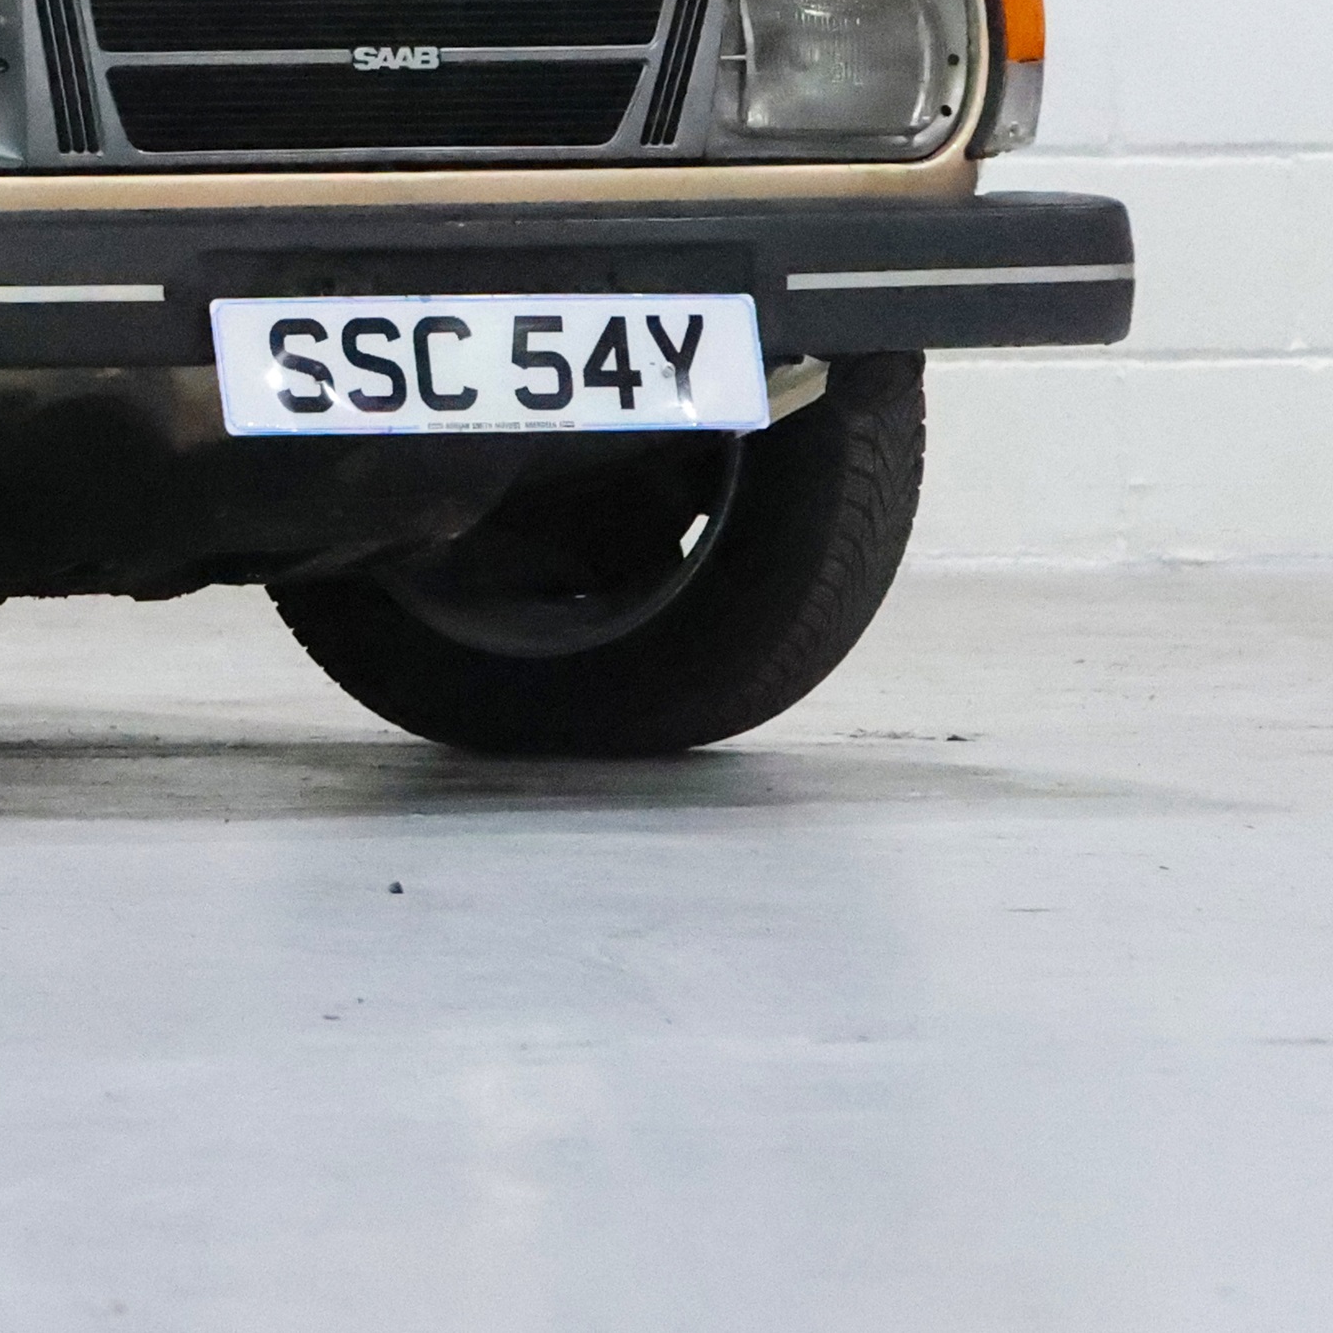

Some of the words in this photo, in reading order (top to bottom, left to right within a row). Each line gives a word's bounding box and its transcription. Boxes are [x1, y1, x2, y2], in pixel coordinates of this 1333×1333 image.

[353, 46, 440, 70] SAAB
[269, 315, 478, 413] SSC
[511, 314, 704, 411] 54Y
